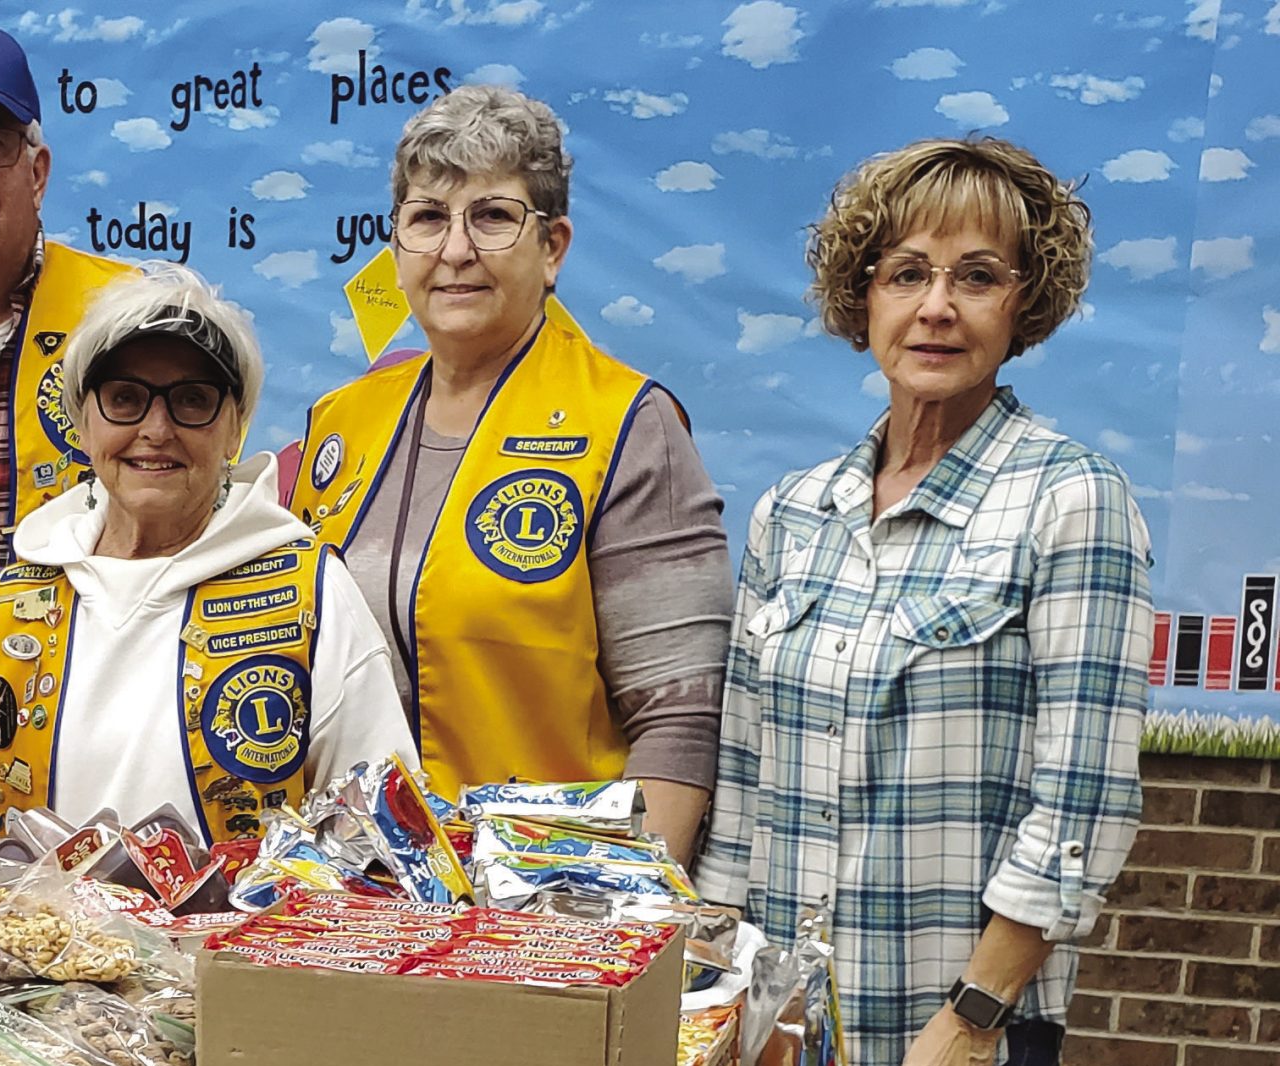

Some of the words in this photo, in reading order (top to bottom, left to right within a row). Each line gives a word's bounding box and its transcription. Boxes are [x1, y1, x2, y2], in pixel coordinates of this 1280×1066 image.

[58, 68, 97, 114] to
[170, 62, 263, 130] great
[330, 49, 452, 124] places
[87, 203, 192, 263] today
[228, 206, 256, 249] is
[515, 440, 578, 452] SECRETARY
[502, 481, 563, 502] LIONS
[515, 507, 545, 541] L
[228, 558, 285, 576] RESIDENT
[495, 545, 558, 565] INTERNATIONAL
[207, 602, 232, 614] LION
[233, 600, 247, 611] OF
[246, 596, 268, 609] THE
[268, 589, 294, 605] YEAR
[211, 637, 238, 650] VICE
[238, 625, 298, 647] PRESIDENT
[227, 669, 291, 696] LIONS
[250, 697, 284, 736] L
[241, 741, 297, 764] INTERNATIONAL
